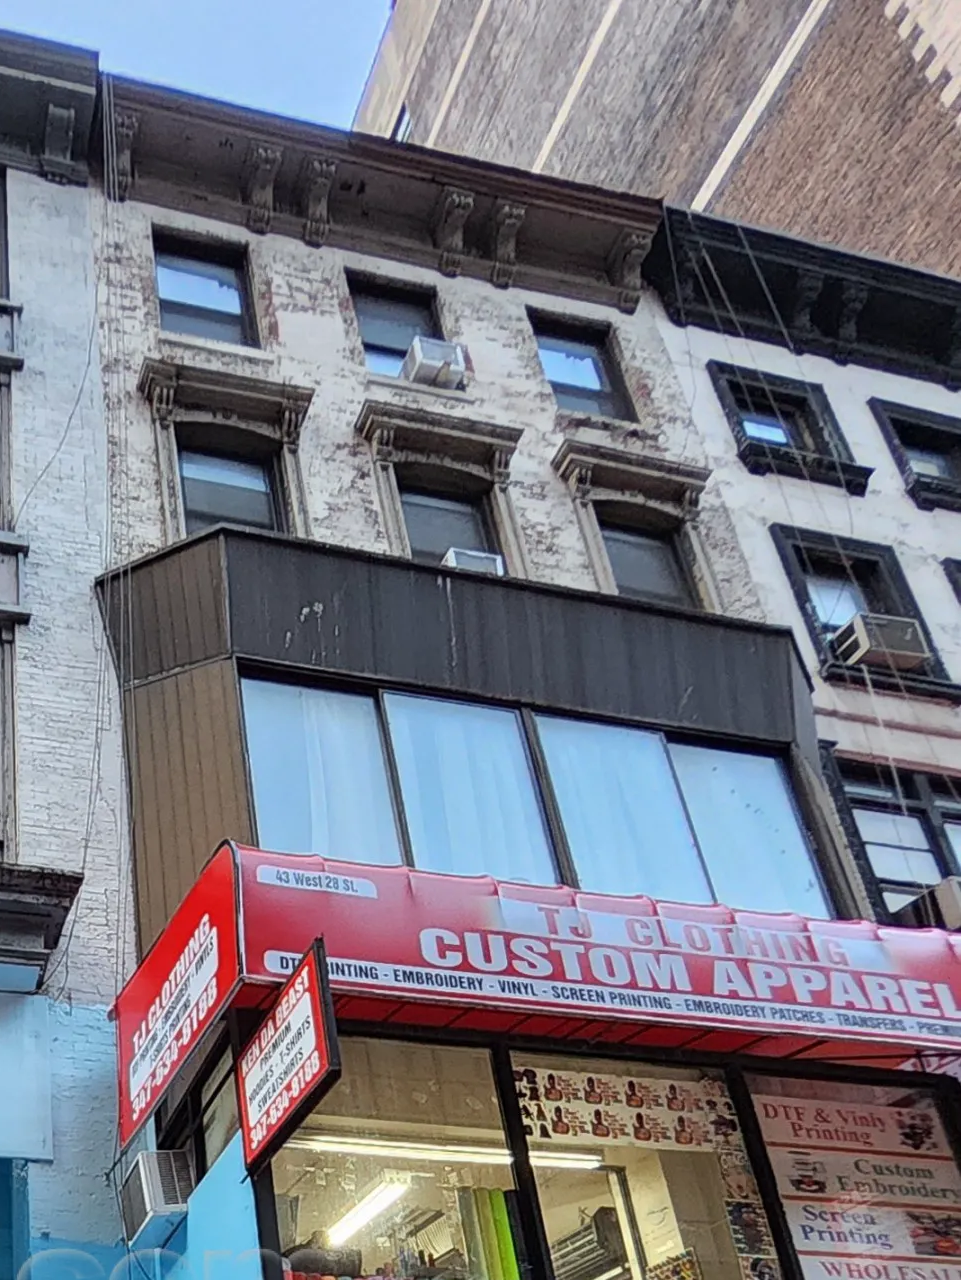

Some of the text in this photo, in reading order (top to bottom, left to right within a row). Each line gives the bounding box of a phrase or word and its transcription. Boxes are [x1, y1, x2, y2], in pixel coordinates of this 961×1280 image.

[275, 869, 290, 885] 43
[294, 871, 322, 888] West
[325, 874, 339, 890] 28
[538, 907, 850, 967] TJ CLOTHING
[147, 913, 210, 1031] CLOTHING
[419, 927, 961, 1017] CUSTOM APPAREL
[327, 962, 379, 980] INTING
[393, 969, 484, 991] EMBROIDERY
[498, 981, 538, 997] VINYL
[551, 985, 606, 1004] SCREEN
[609, 991, 672, 1010] PRINTING
[685, 999, 768, 1020] EMBROIDERY
[770, 1006, 827, 1025] PATCHES
[240, 966, 310, 1078] KEN DA BEAST
[259, 1019, 292, 1071] PREMIUM
[762, 1102, 806, 1123] DTF
[813, 1107, 831, 1125] &
[790, 1121, 874, 1147] Printing
[854, 1158, 935, 1179] Custom
[801, 1204, 877, 1226] Screen
[800, 1224, 893, 1250] Printing
